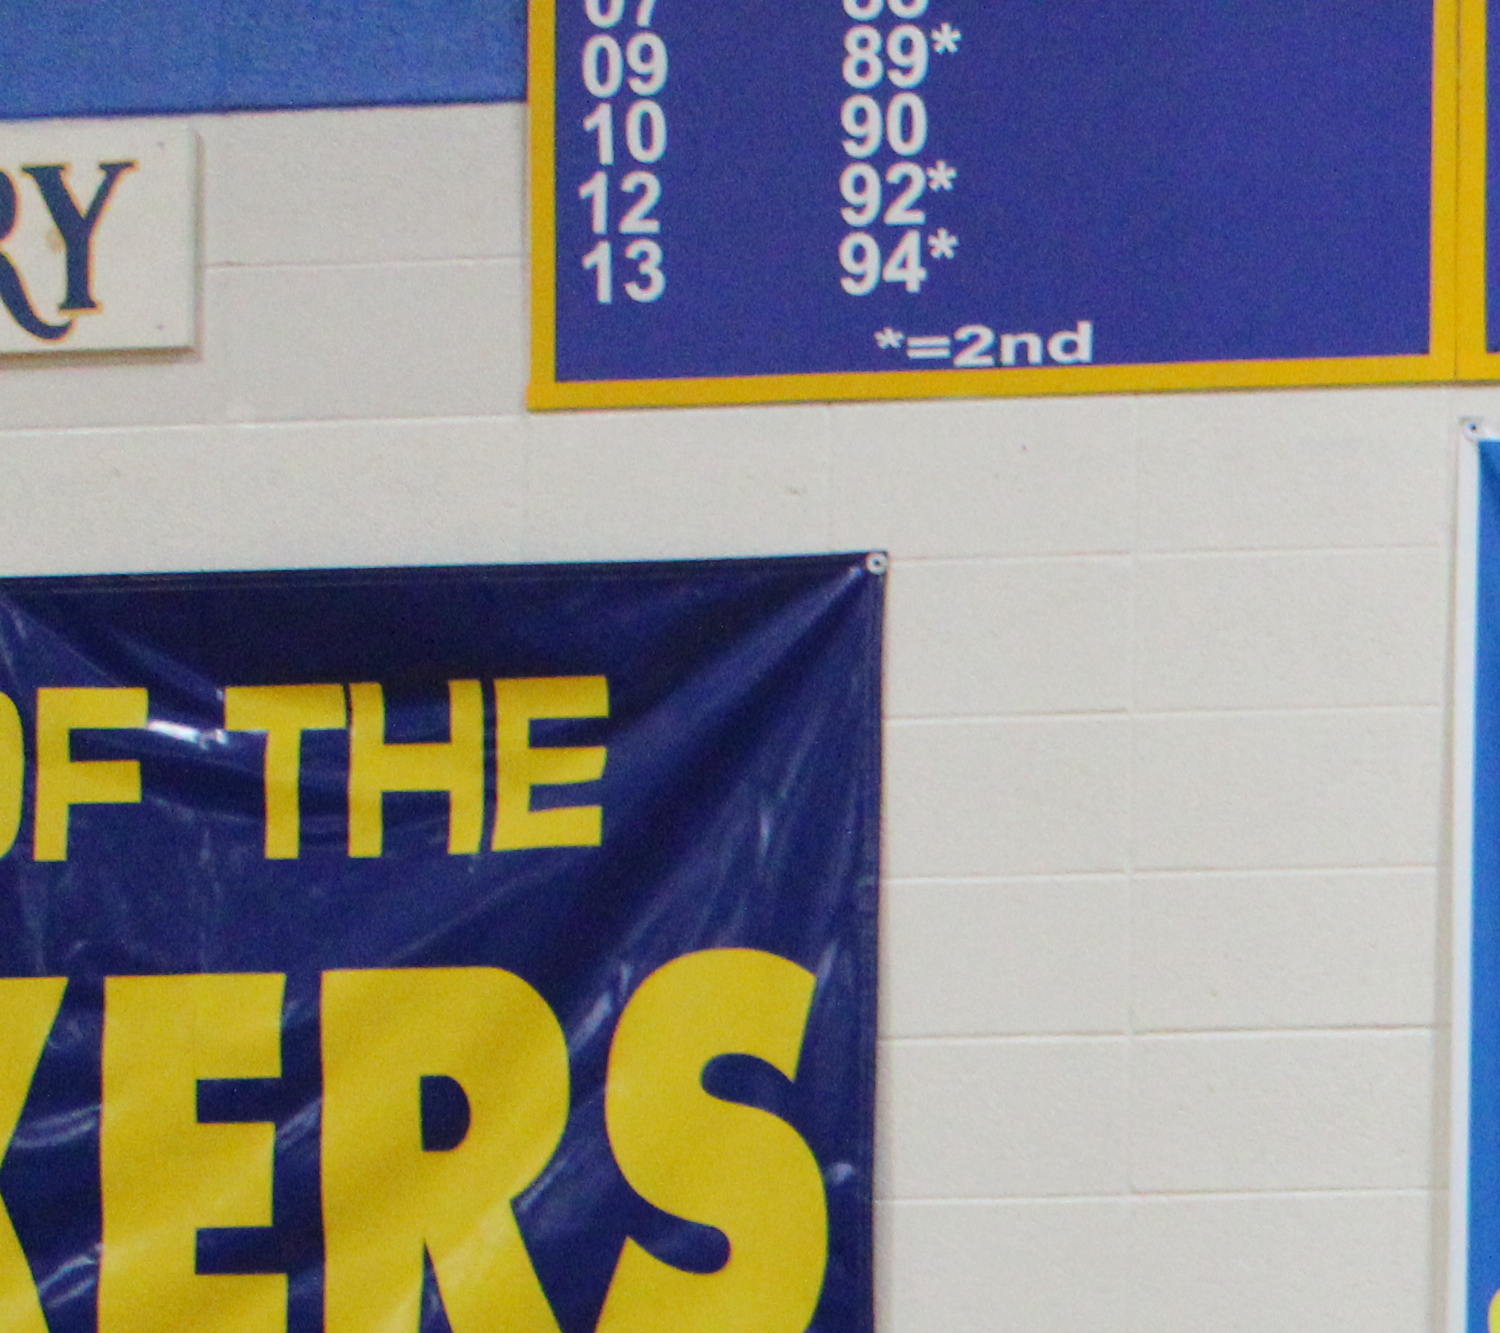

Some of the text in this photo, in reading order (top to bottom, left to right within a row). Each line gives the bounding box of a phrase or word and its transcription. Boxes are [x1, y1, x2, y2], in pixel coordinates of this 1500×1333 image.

[581, 32, 668, 97] 09
[582, 100, 667, 165] 10
[841, 93, 928, 158] 90
[578, 171, 662, 234] 12
[581, 239, 666, 304] 13
[0, 674, 610, 862] F THE
